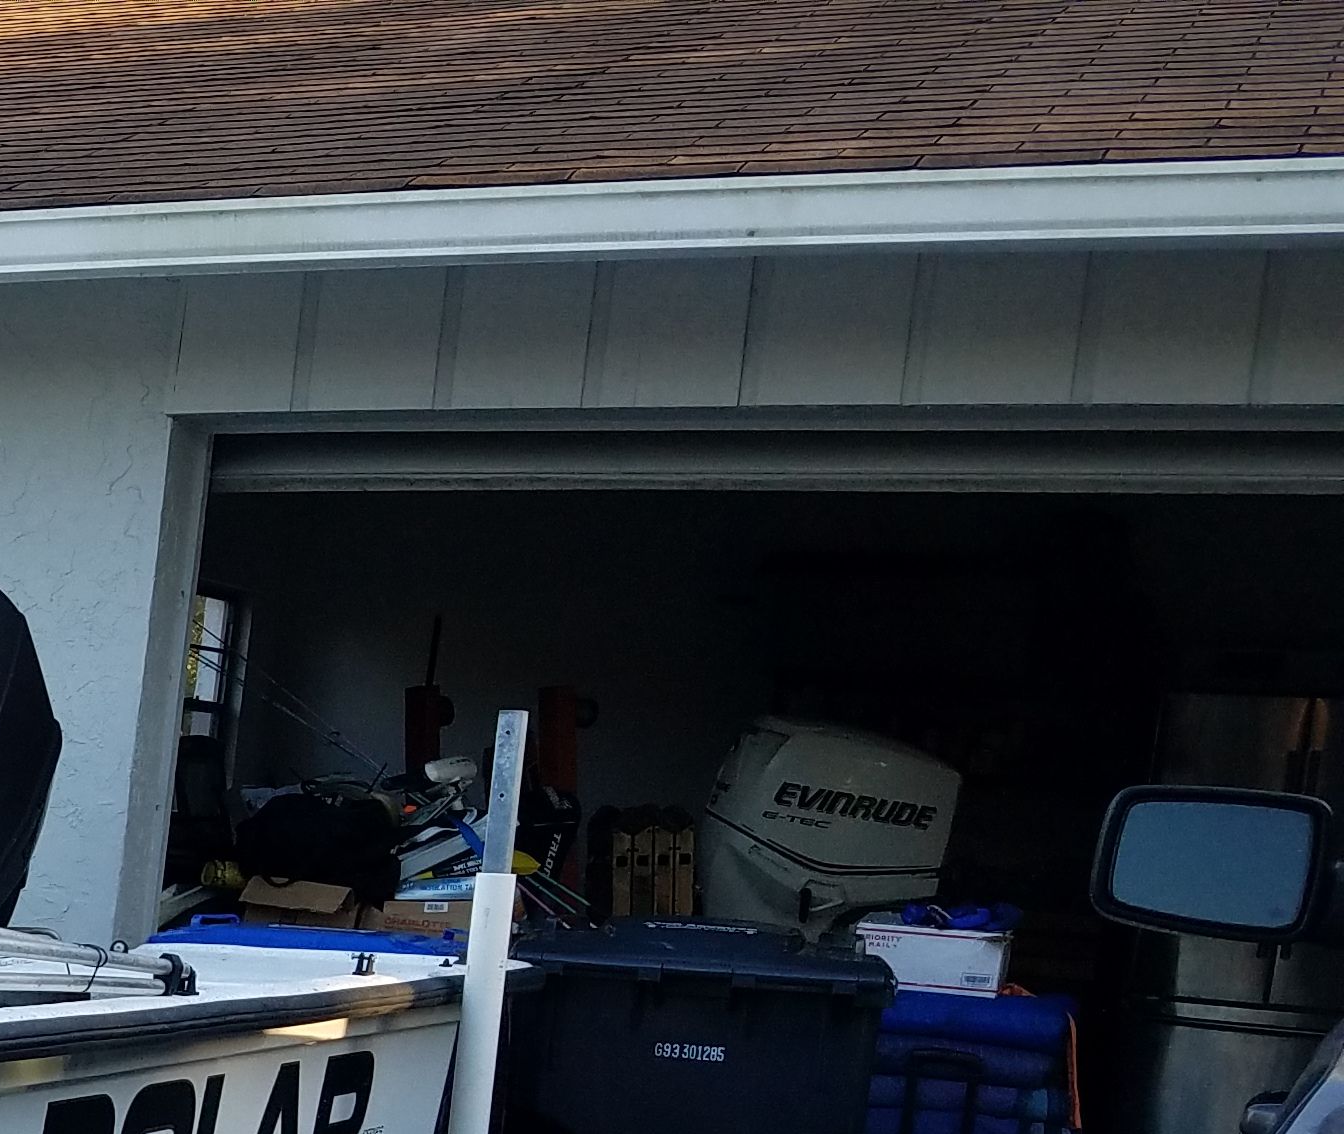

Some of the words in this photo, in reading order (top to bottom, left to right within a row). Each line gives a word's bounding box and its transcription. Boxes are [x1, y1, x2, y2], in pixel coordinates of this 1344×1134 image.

[773, 781, 937, 831] EVINRUDE
[761, 809, 833, 829] E-TEC
[654, 1042, 680, 1059] G93
[681, 1043, 727, 1063] 301285
